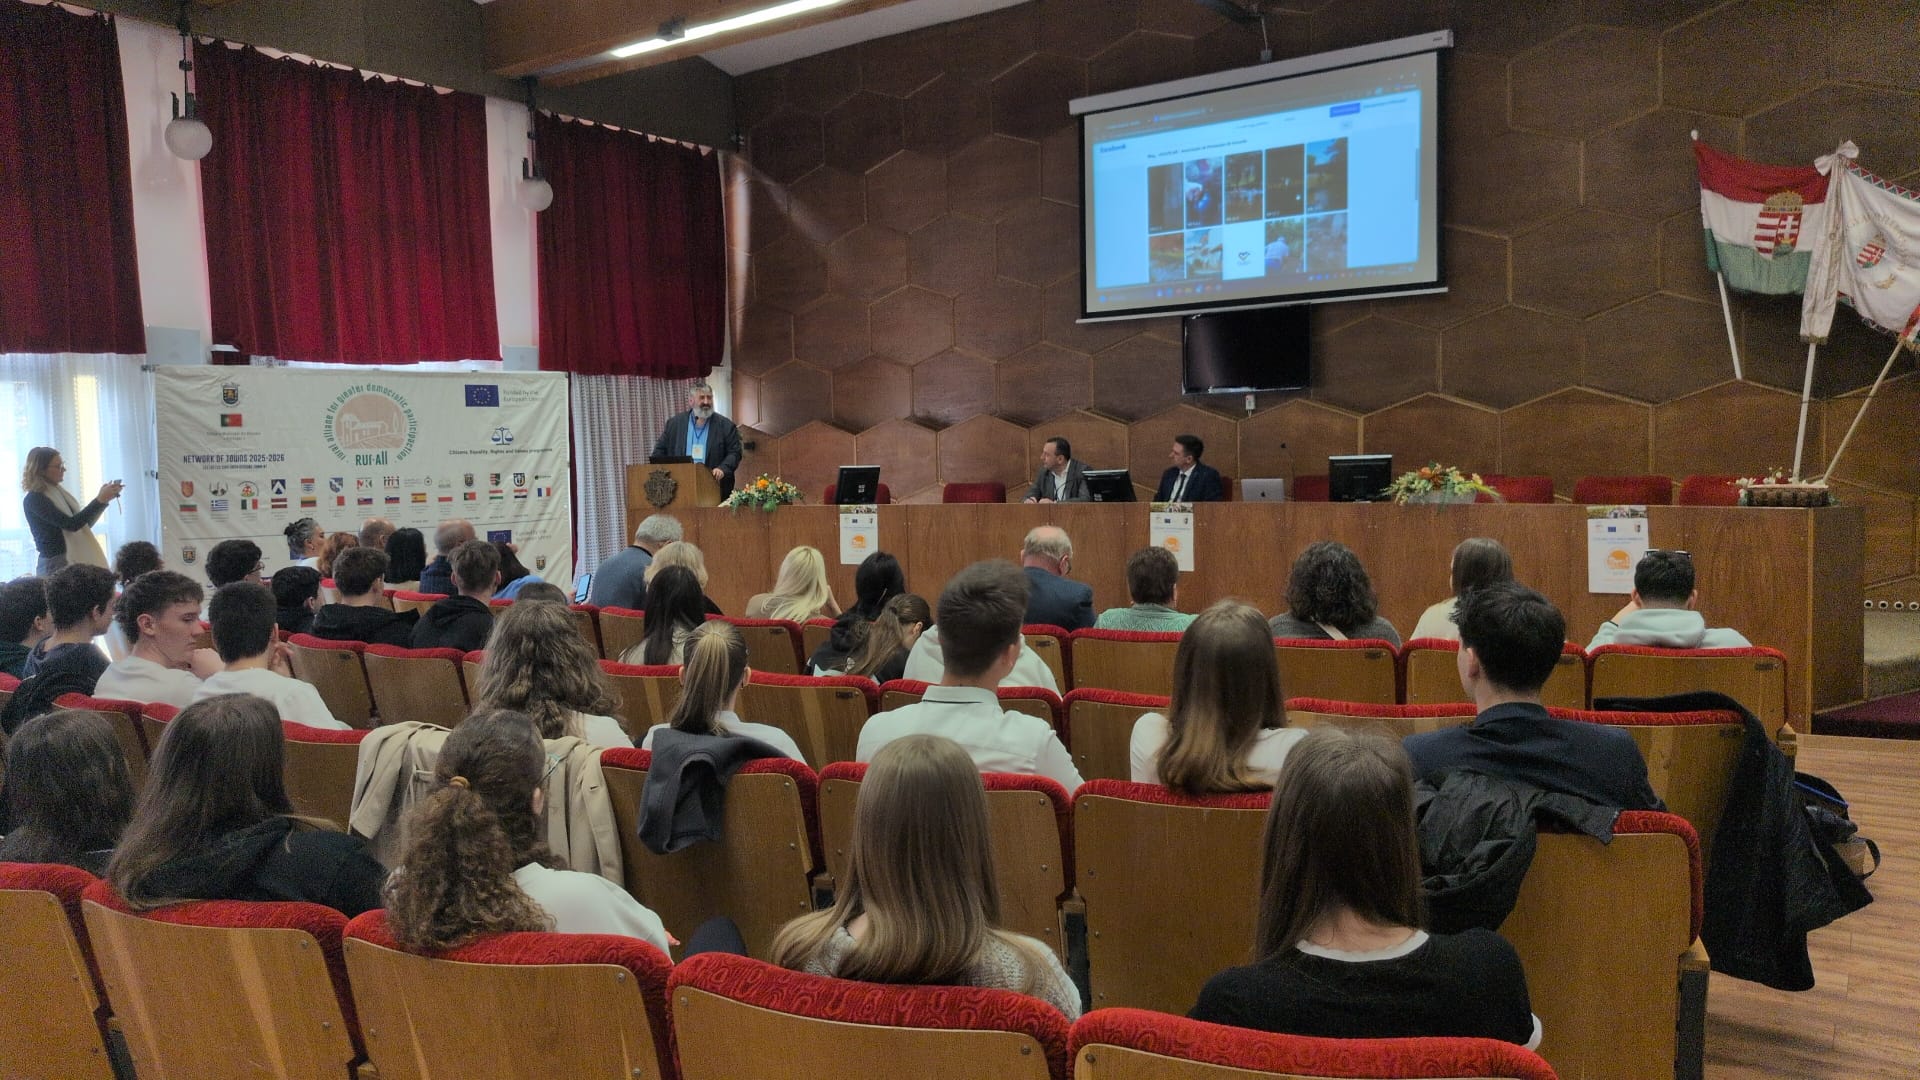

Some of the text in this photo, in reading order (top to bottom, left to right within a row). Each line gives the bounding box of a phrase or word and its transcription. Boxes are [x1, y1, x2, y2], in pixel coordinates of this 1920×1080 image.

[327, 402, 339, 413] for
[336, 384, 364, 404] greater
[366, 383, 408, 409] democratic
[183, 454, 215, 464] NETWORK
[216, 454, 225, 462] OF
